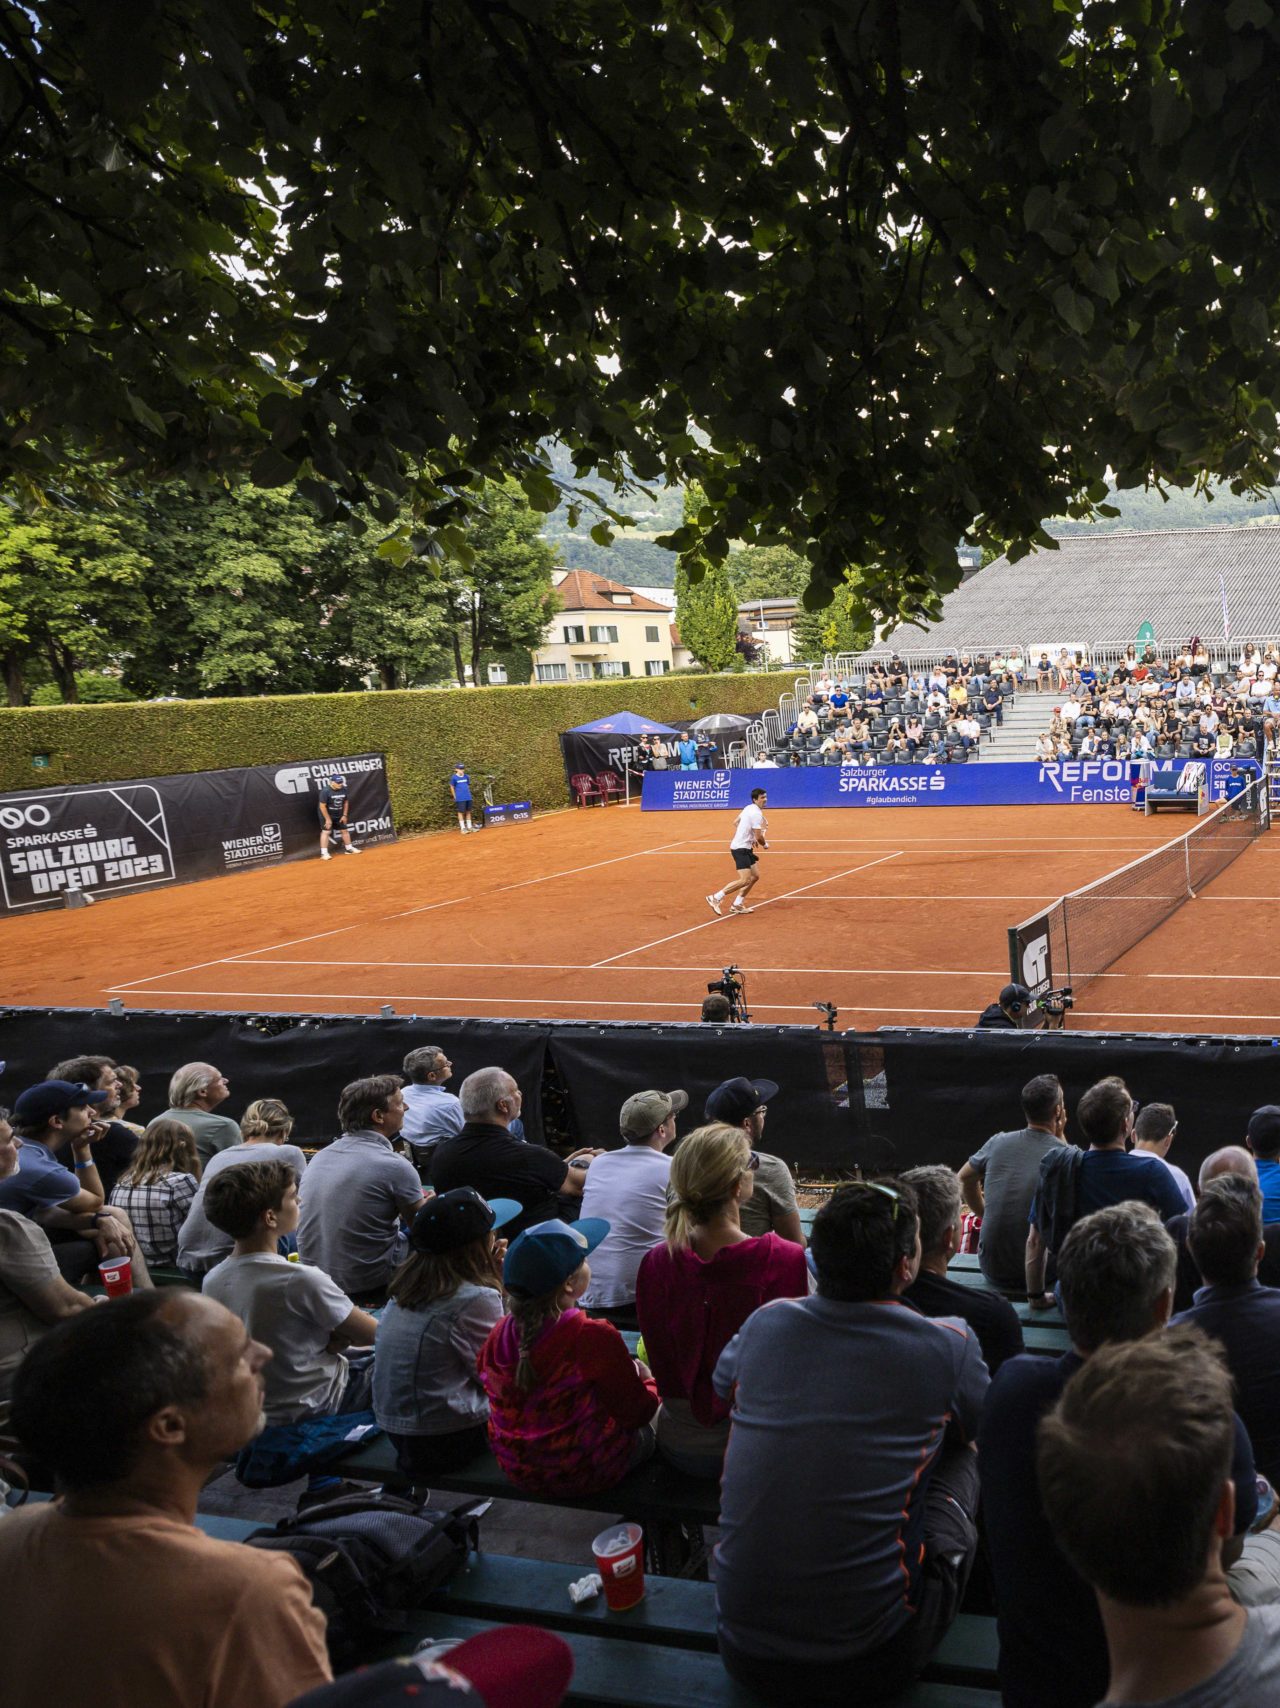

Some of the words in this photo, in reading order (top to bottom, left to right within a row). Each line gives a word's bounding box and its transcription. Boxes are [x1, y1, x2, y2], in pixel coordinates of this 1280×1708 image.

[34, 756, 44, 766] 5
[311, 757, 383, 778] CHALLENGER
[840, 768, 887, 778] Salzburger
[674, 780, 712, 790] WIENER
[839, 776, 927, 792] SPARKASSE
[673, 788, 729, 800] STÄDTISCHE
[866, 795, 917, 804] #glaubandich
[490, 815, 505, 823] 206
[513, 812, 529, 820] 0:15
[6, 828, 84, 849] SPARKASSE
[221, 836, 264, 851] WIENER
[9, 836, 138, 874] SALZBURG
[223, 841, 284, 861] STÄDTISCHE
[30, 865, 99, 895] OPEN
[103, 853, 165, 882] 2023
